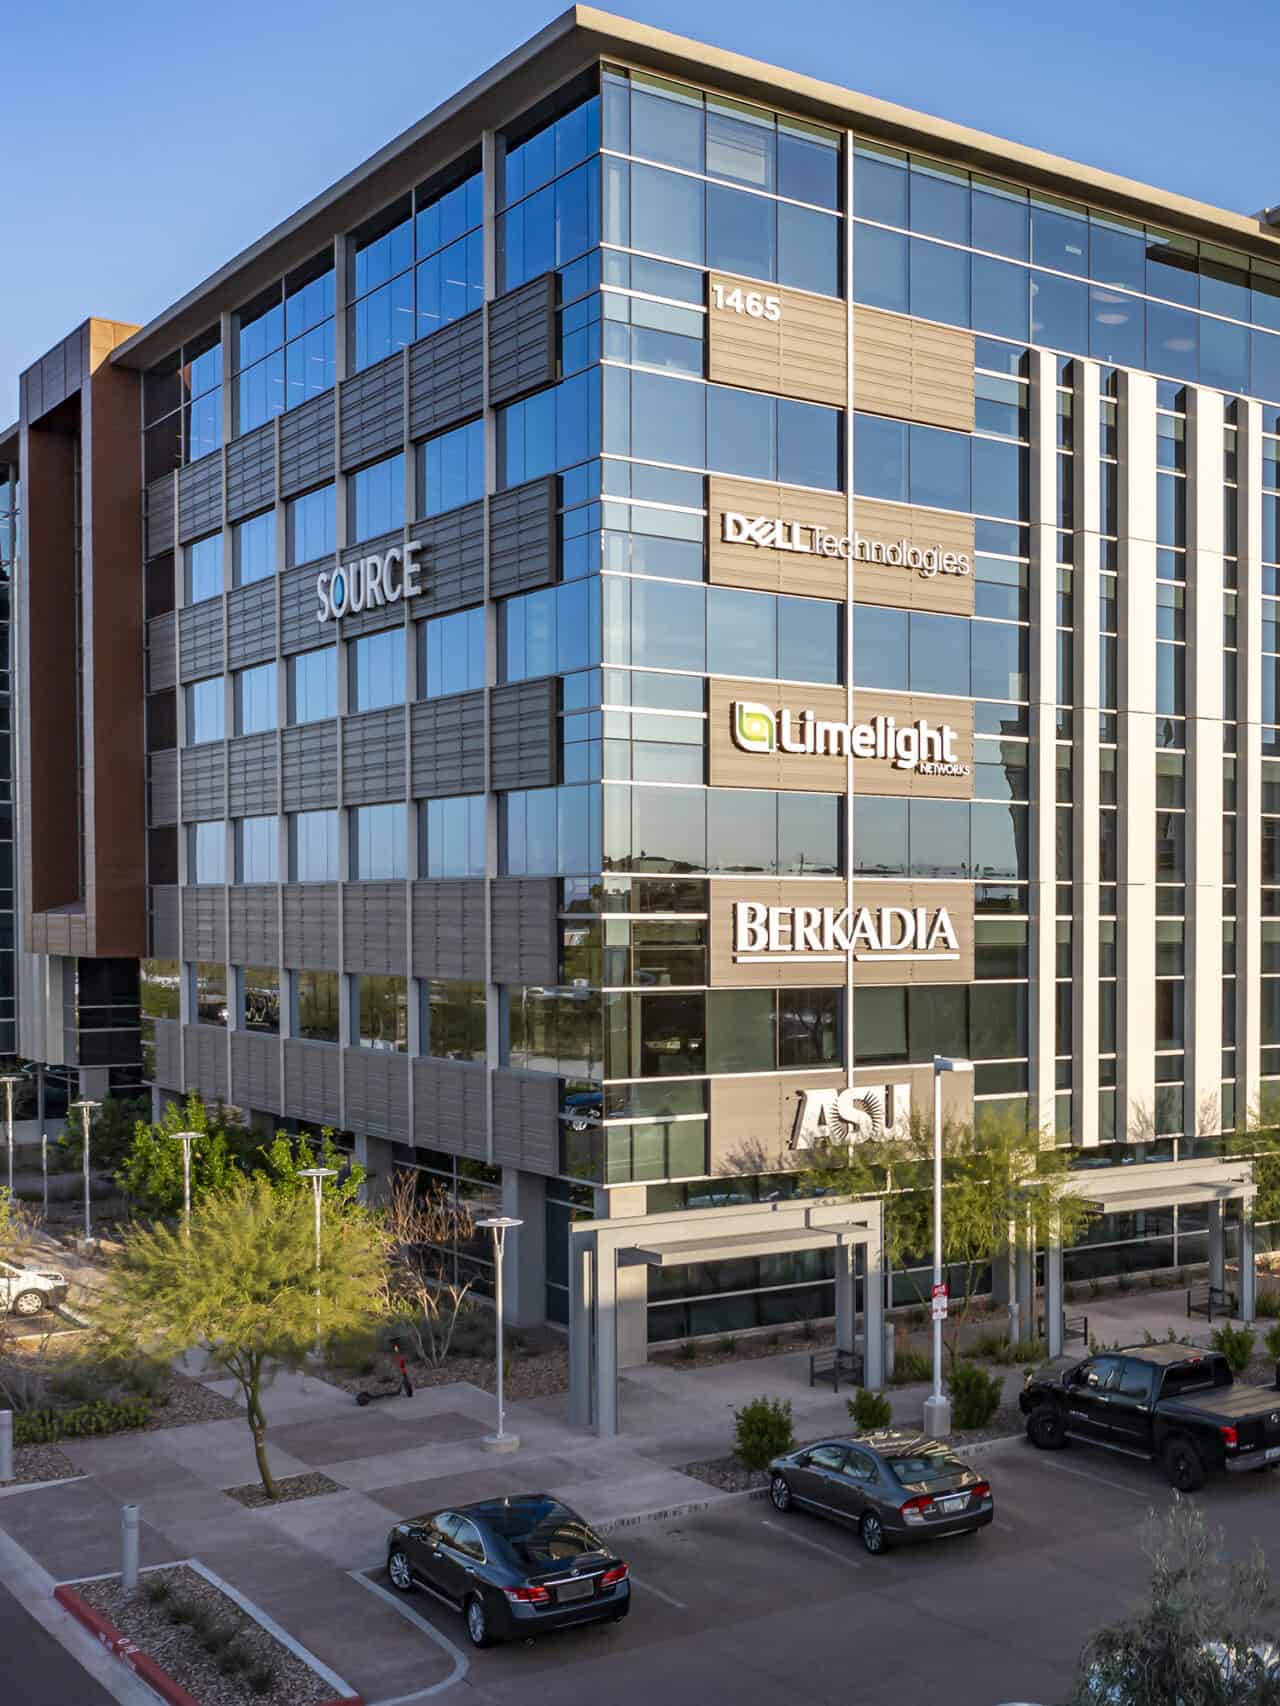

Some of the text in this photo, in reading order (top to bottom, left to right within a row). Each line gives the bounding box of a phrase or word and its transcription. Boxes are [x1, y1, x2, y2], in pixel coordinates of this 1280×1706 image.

[712, 284, 781, 321] 1465
[724, 511, 970, 577] DELL Technologies
[316, 541, 422, 623] SOURCE
[780, 708, 958, 769] Limelight
[735, 902, 960, 951] BERKADIA
[792, 1083, 912, 1151] ASU
